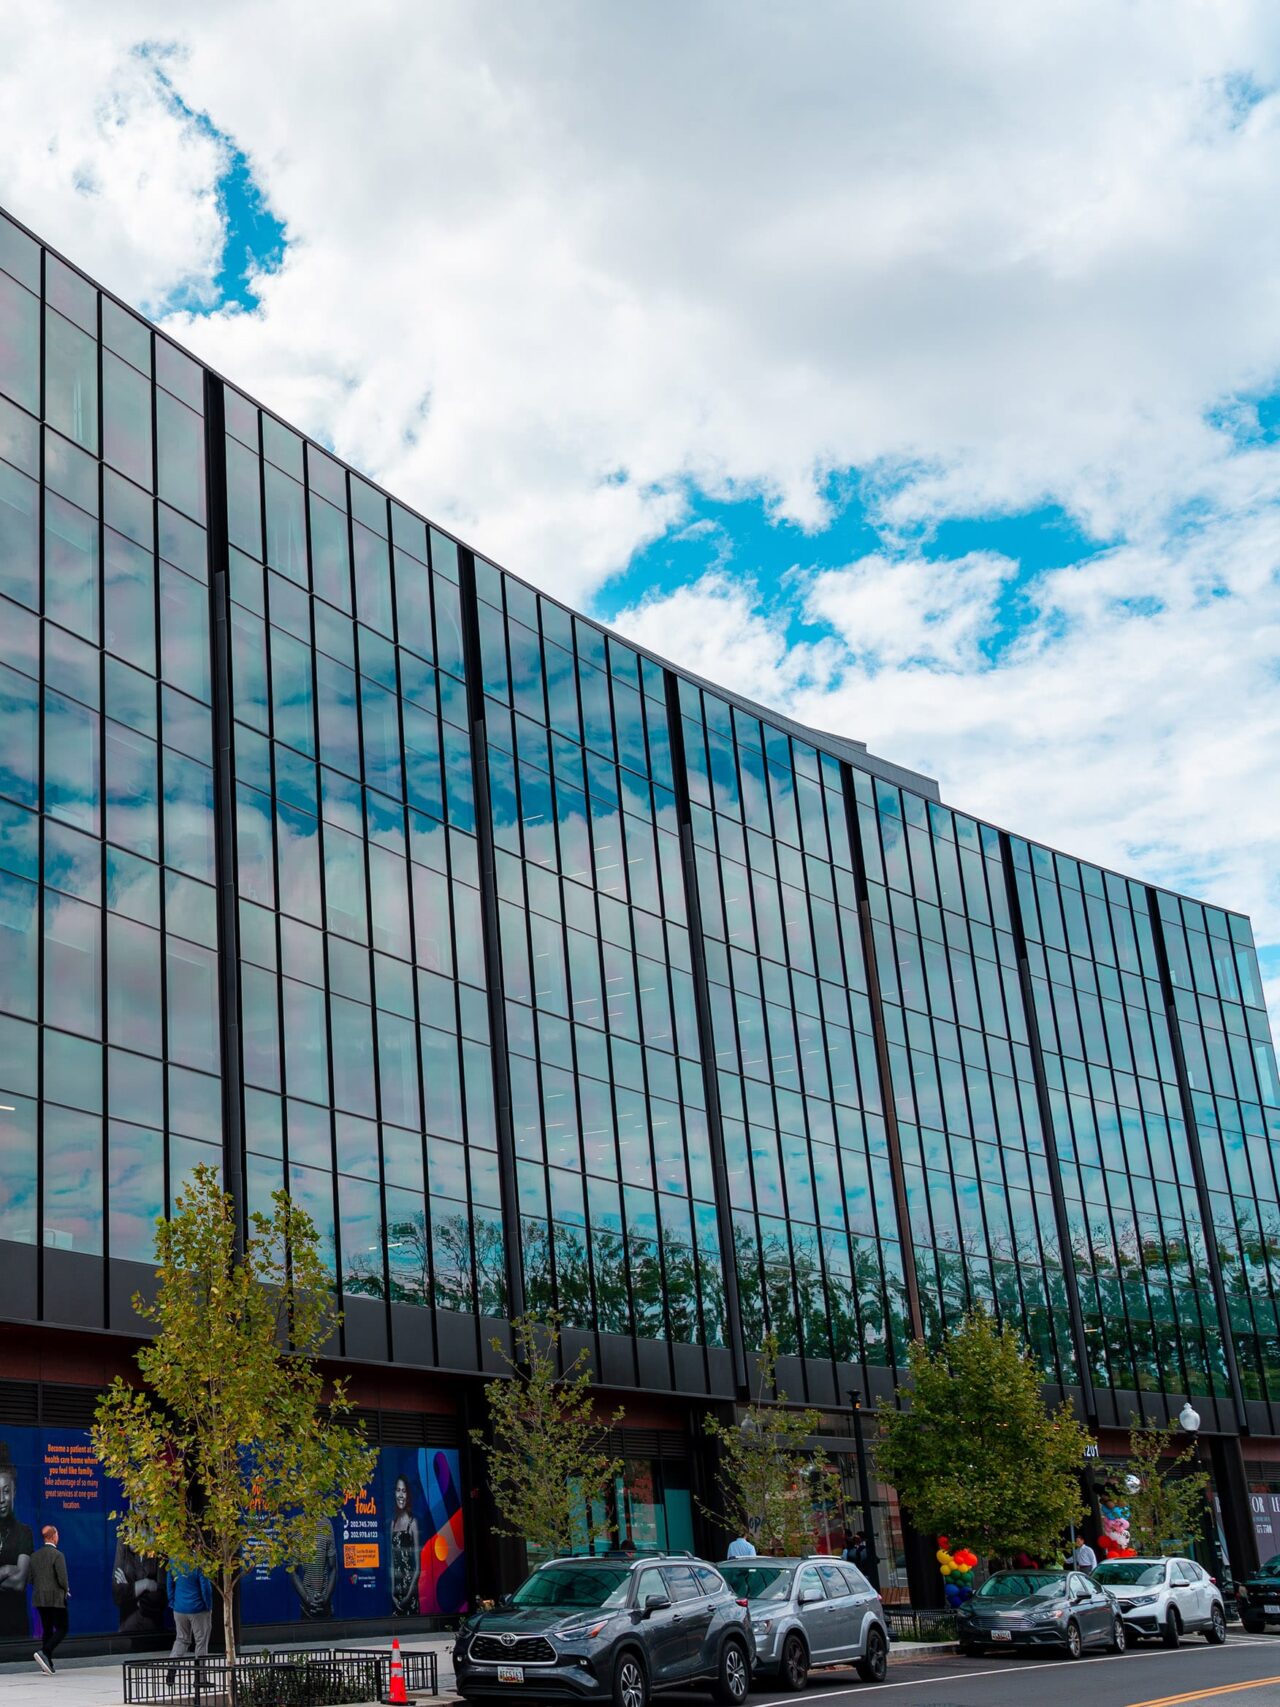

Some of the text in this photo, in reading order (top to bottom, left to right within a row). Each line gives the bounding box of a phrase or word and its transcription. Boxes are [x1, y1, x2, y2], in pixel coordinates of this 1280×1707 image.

[48, 1444, 66, 1452] Become
[70, 1446, 86, 1454] patient
[44, 1455, 60, 1464] health
[70, 1456, 83, 1465] home
[83, 1457, 99, 1465] where
[49, 1466, 94, 1477] you feel like family.
[44, 1476, 54, 1486] Take
[54, 1477, 76, 1488] advantage
[87, 1480, 98, 1488] many
[45, 1490, 56, 1499] great
[57, 1490, 73, 1498] services
[86, 1490, 98, 1500] great
[63, 1501, 80, 1509] location.
[354, 1497, 377, 1515] touch
[1250, 1496, 1265, 1513] OR
[350, 1520, 378, 1528] 202.745.7000
[350, 1531, 378, 1539] 202.978.6123
